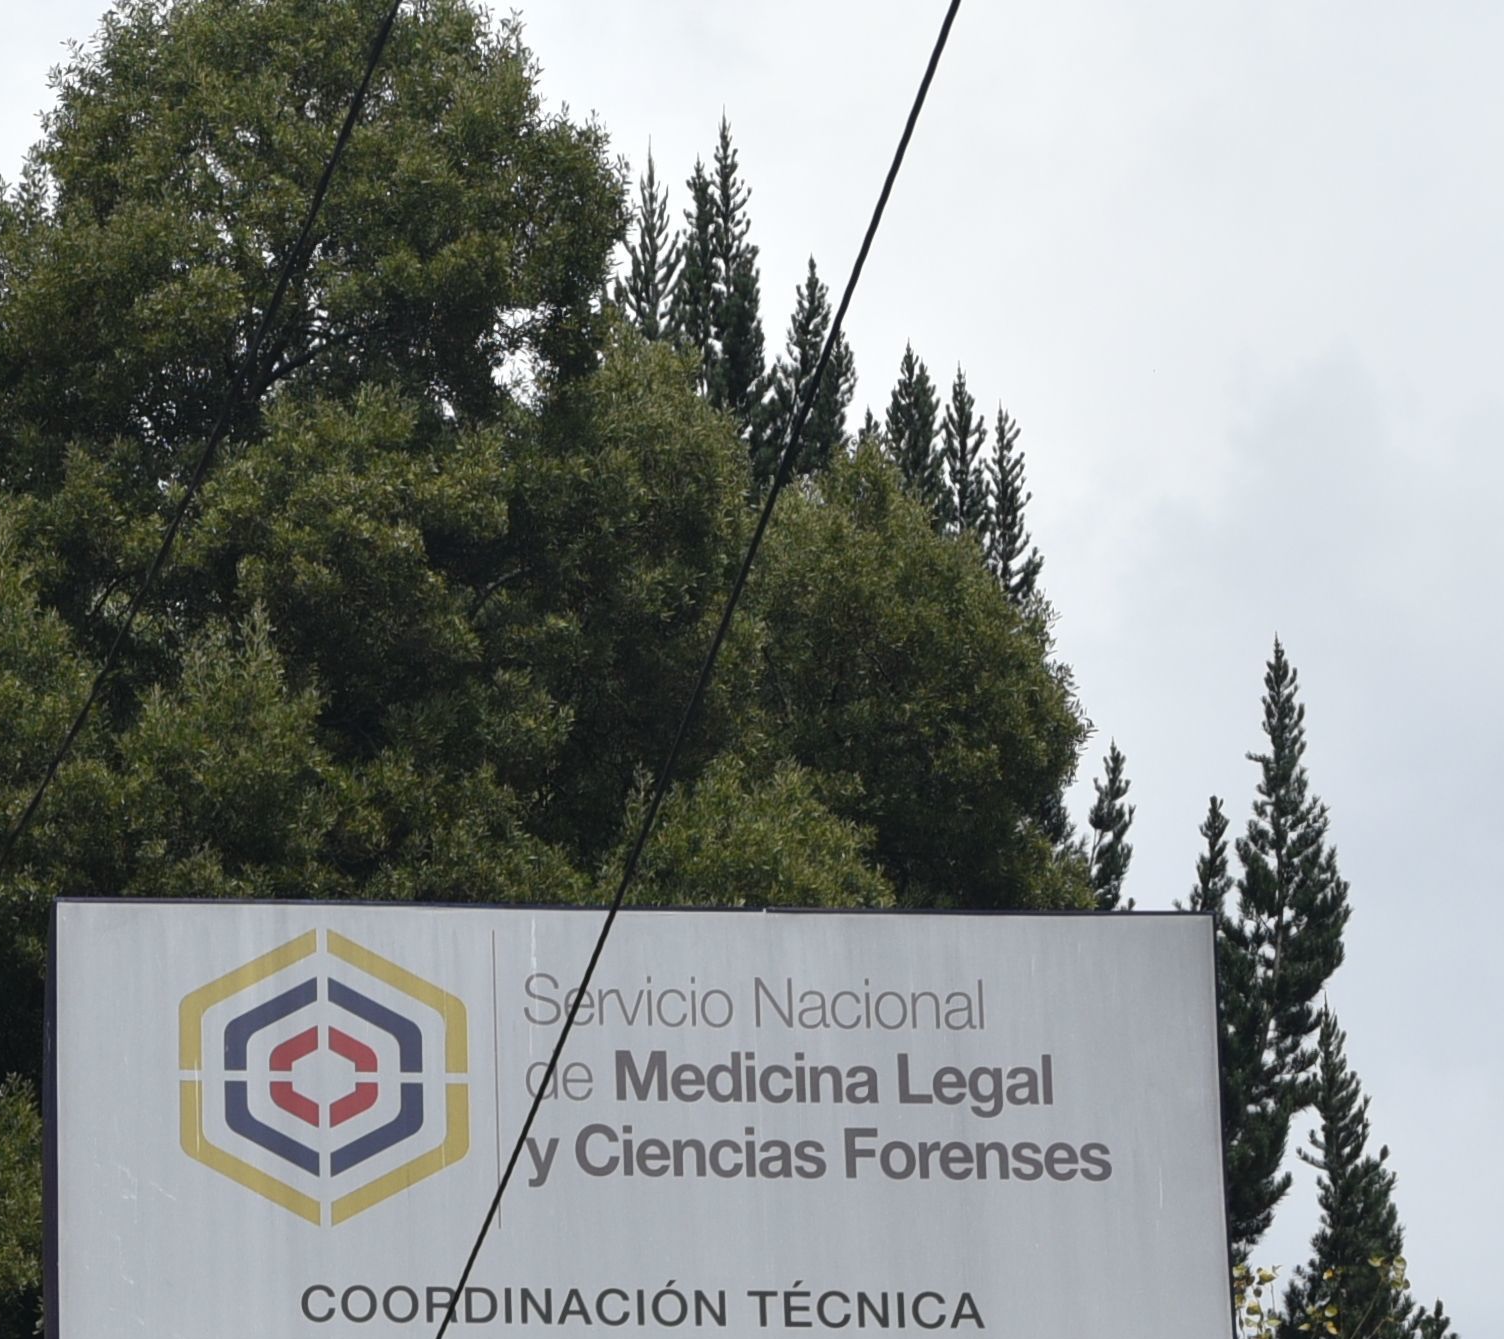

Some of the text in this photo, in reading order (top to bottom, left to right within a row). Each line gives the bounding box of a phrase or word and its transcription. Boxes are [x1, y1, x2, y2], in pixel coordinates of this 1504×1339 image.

[524, 972, 986, 1034] Servicio Nacional
[526, 1050, 1055, 1120] de Medicina Legal
[525, 1125, 1113, 1189] y Ciencias Forenses
[300, 1279, 985, 1330] COORDINACIÓN TÉCNICA
